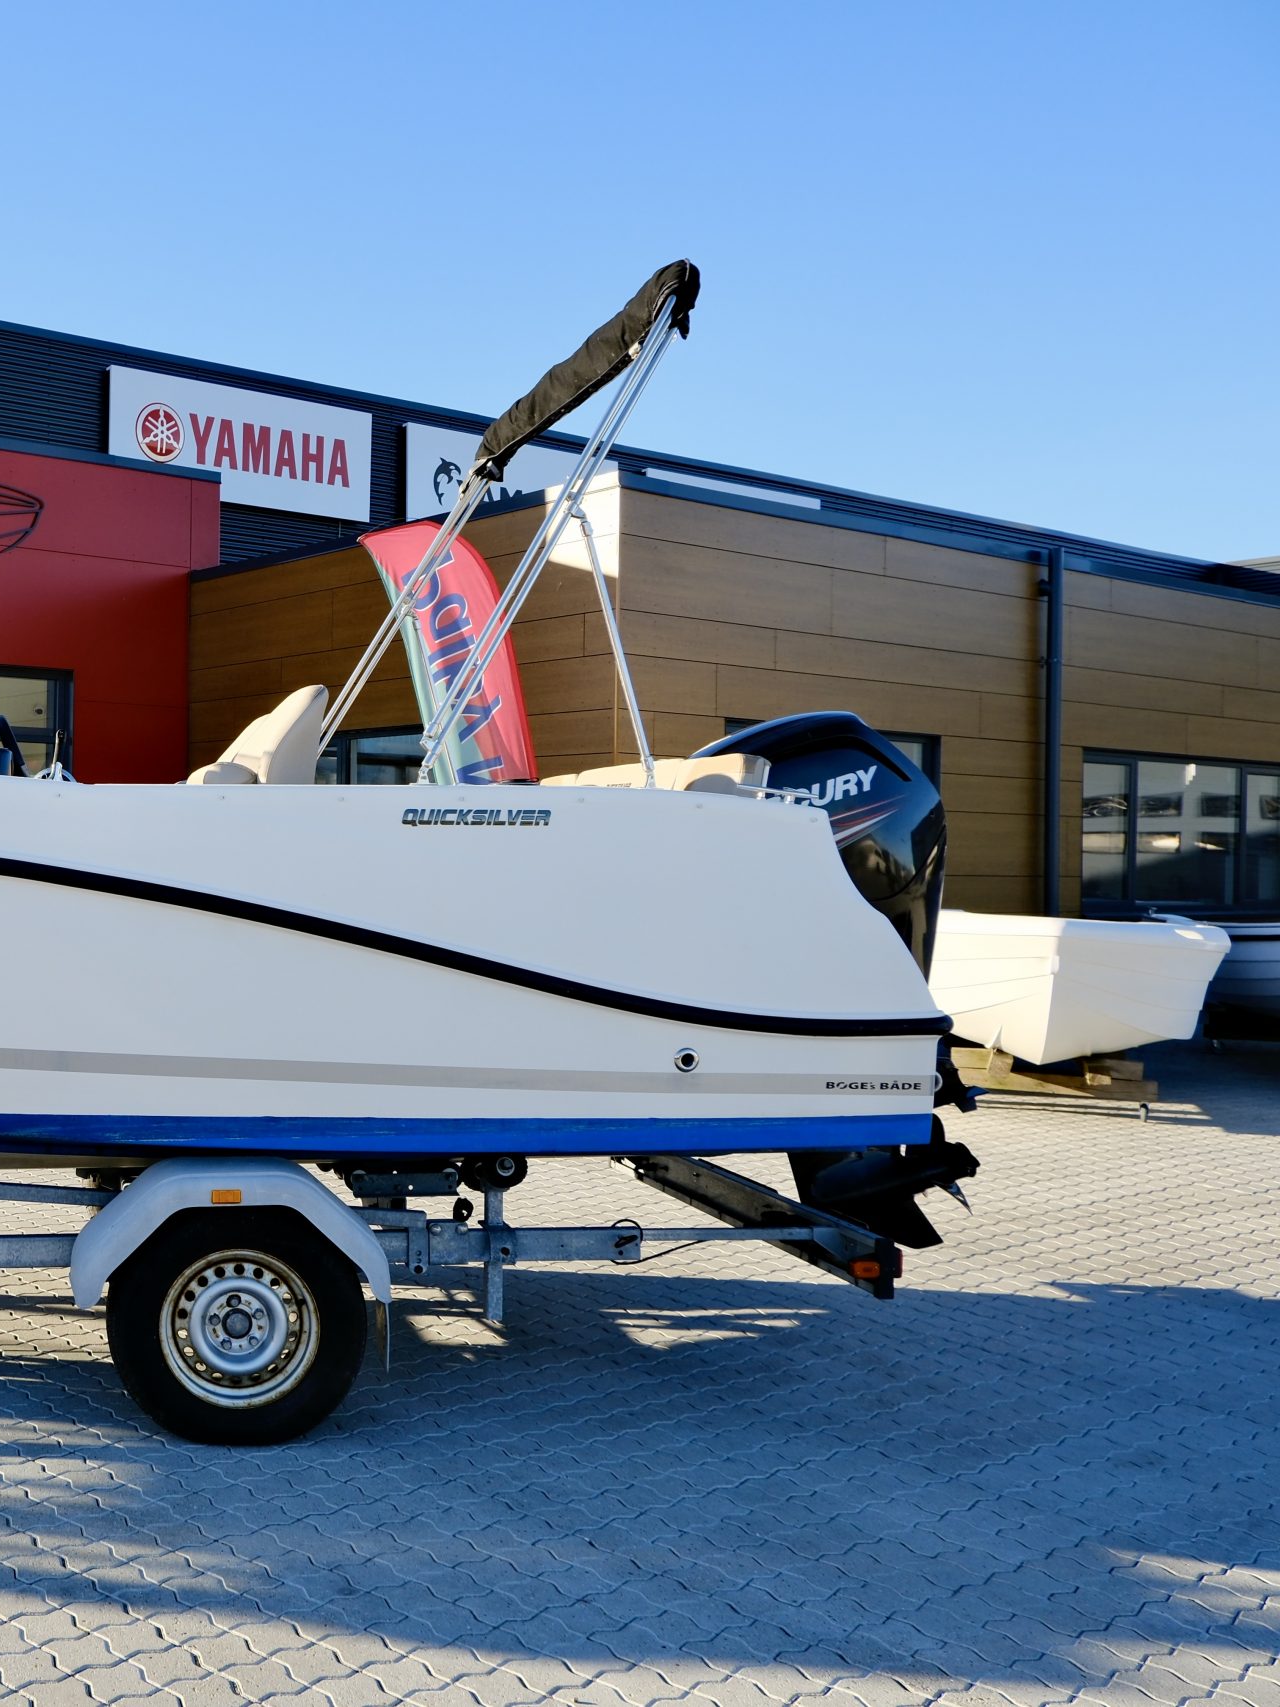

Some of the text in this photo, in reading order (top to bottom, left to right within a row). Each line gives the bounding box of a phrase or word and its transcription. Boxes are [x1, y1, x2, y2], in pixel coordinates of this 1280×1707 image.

[189, 412, 350, 488] YAMAHA
[401, 808, 552, 827] QUICKSILVER
[880, 1080, 922, 1091] BÅDE
